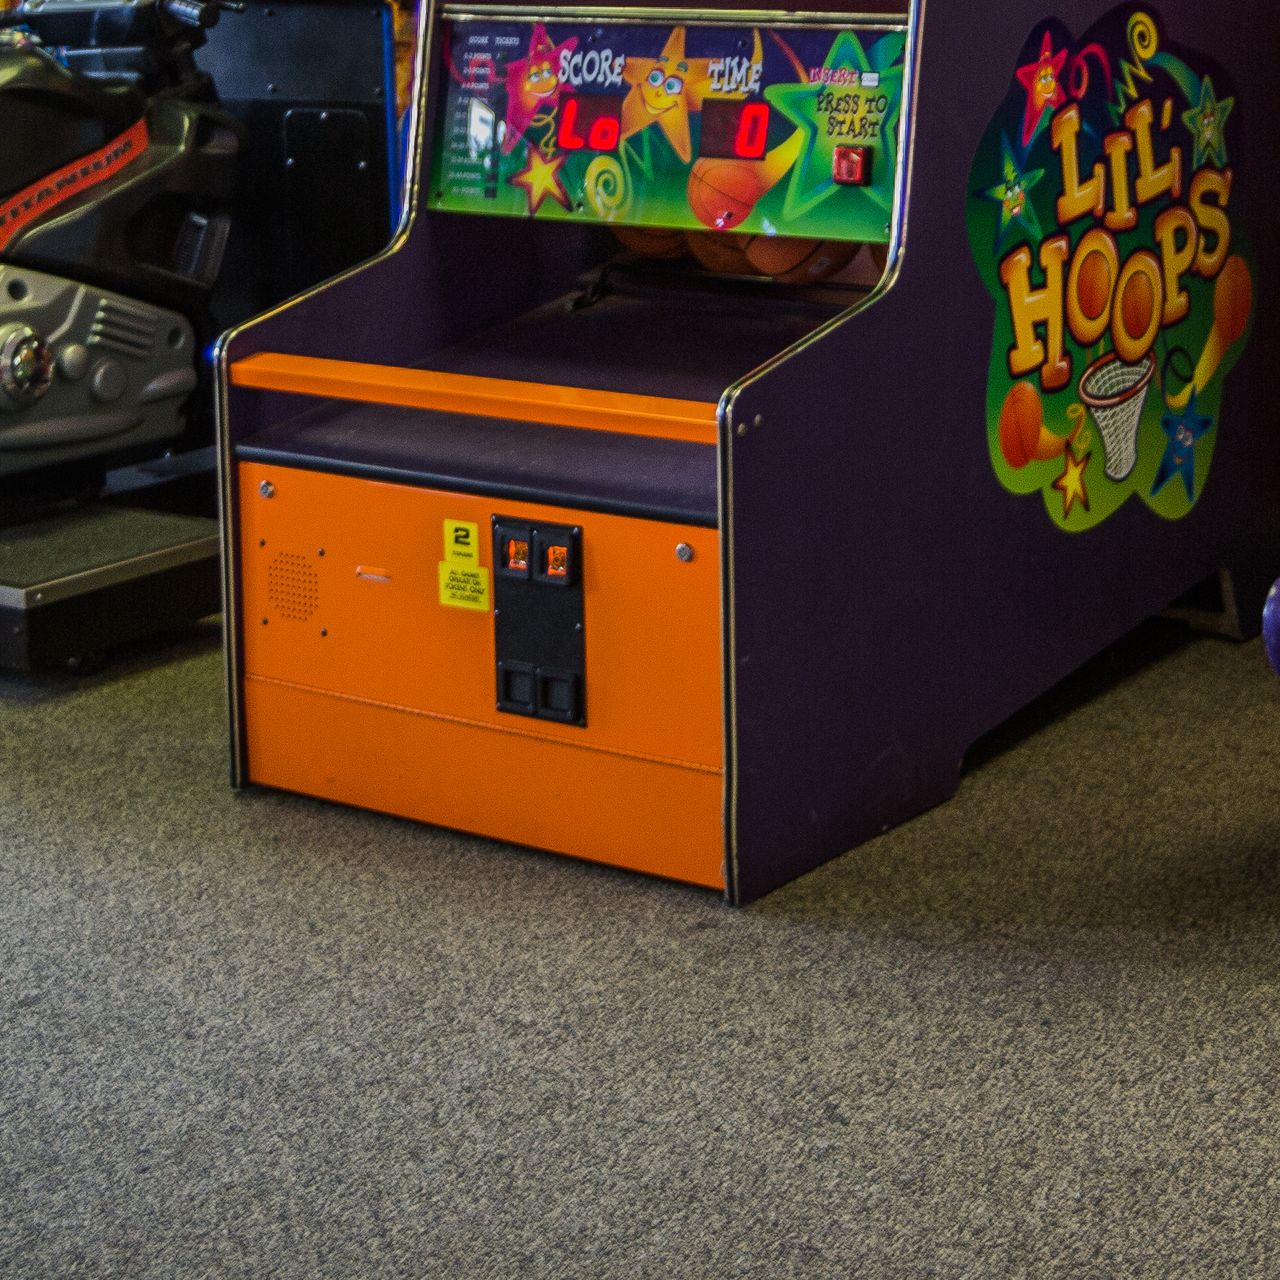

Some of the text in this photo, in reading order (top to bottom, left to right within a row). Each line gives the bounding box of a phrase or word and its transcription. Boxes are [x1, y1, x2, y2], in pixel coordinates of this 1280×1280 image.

[558, 48, 625, 87] SCORE
[709, 55, 763, 94] TIME
[816, 91, 888, 115] PRESS TO
[827, 115, 879, 139] START
[1000, 167, 1233, 393] HOOPS
[454, 526, 471, 546] 2
